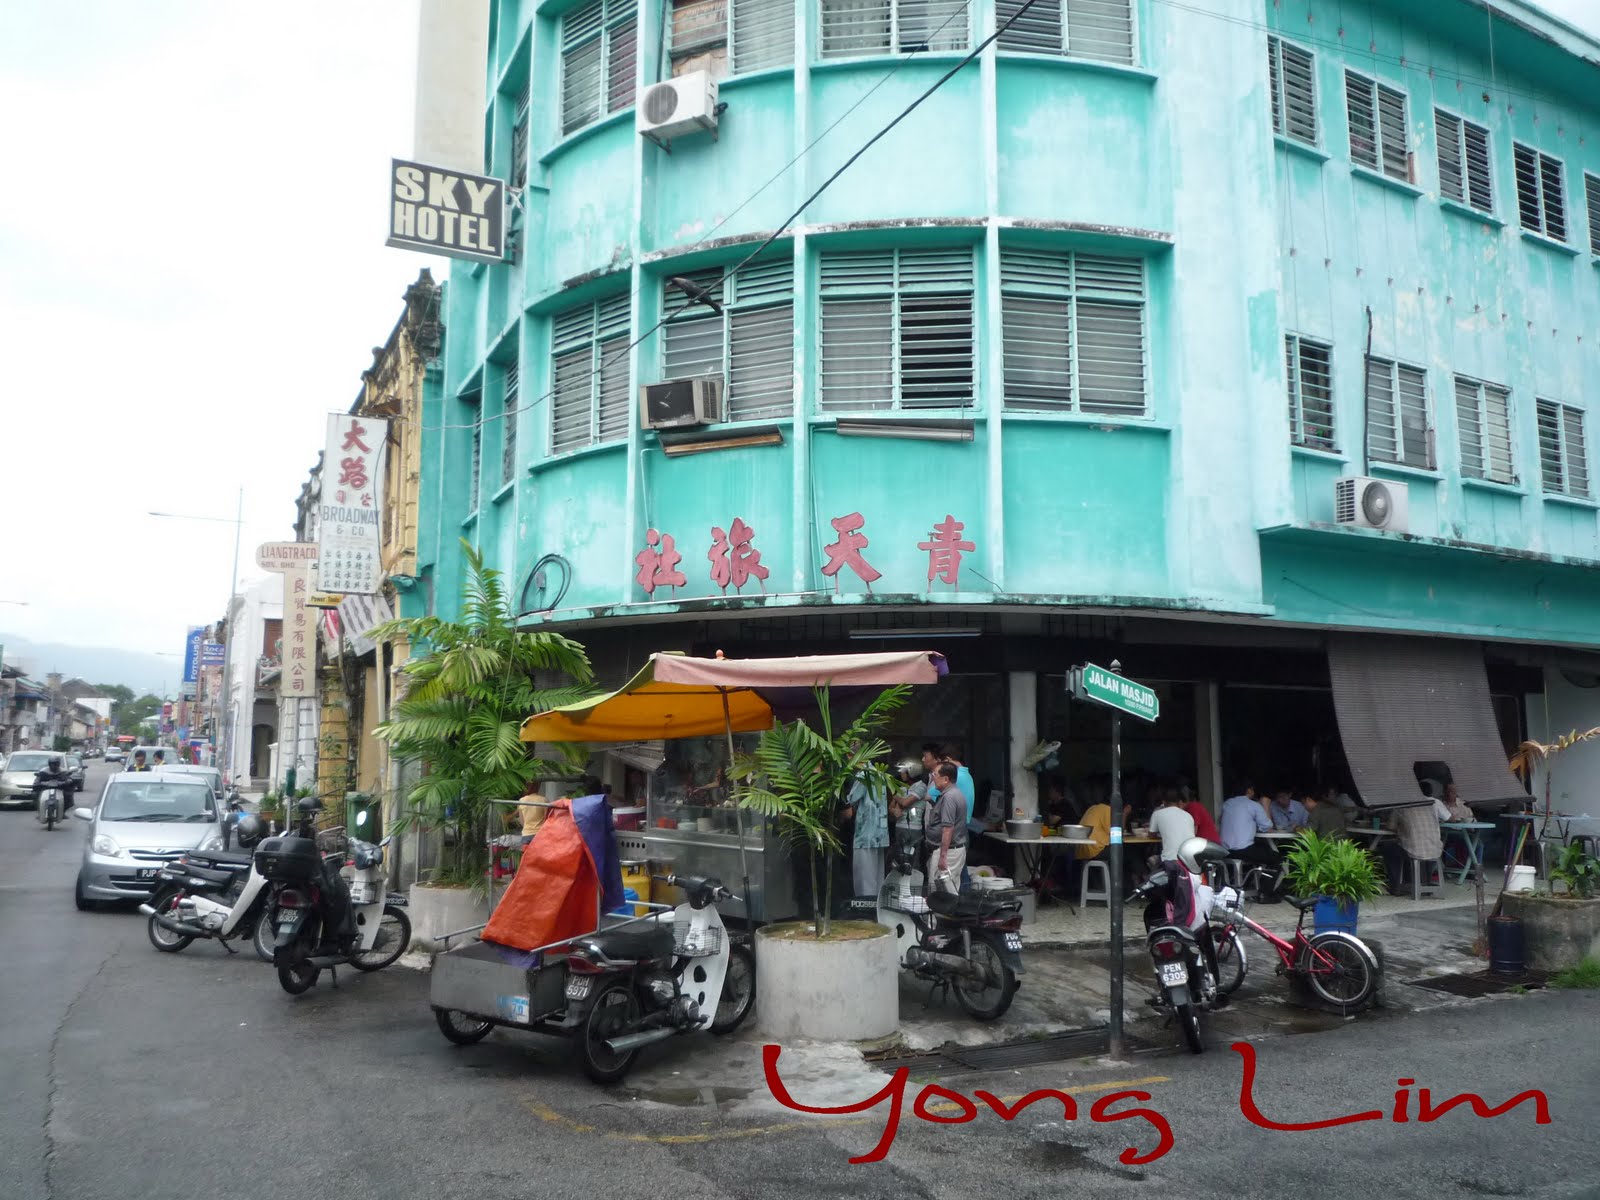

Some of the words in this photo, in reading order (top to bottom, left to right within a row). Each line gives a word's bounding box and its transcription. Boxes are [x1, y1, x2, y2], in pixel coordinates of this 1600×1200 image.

[395, 166, 496, 215] SKY
[393, 200, 496, 252] HOTEL
[338, 419, 372, 490] 大路
[323, 505, 380, 525] BROADWAY
[352, 526, 364, 536] CO
[261, 546, 317, 559] LIANGTRACO
[1088, 671, 1119, 693] JALAN
[1121, 683, 1154, 708] MASJID
[142, 869, 156, 877] PJP
[1008, 941, 1022, 949] 556
[1164, 963, 1181, 973] PEN
[1163, 971, 1186, 981] 6305
[567, 985, 588, 997] 5971
